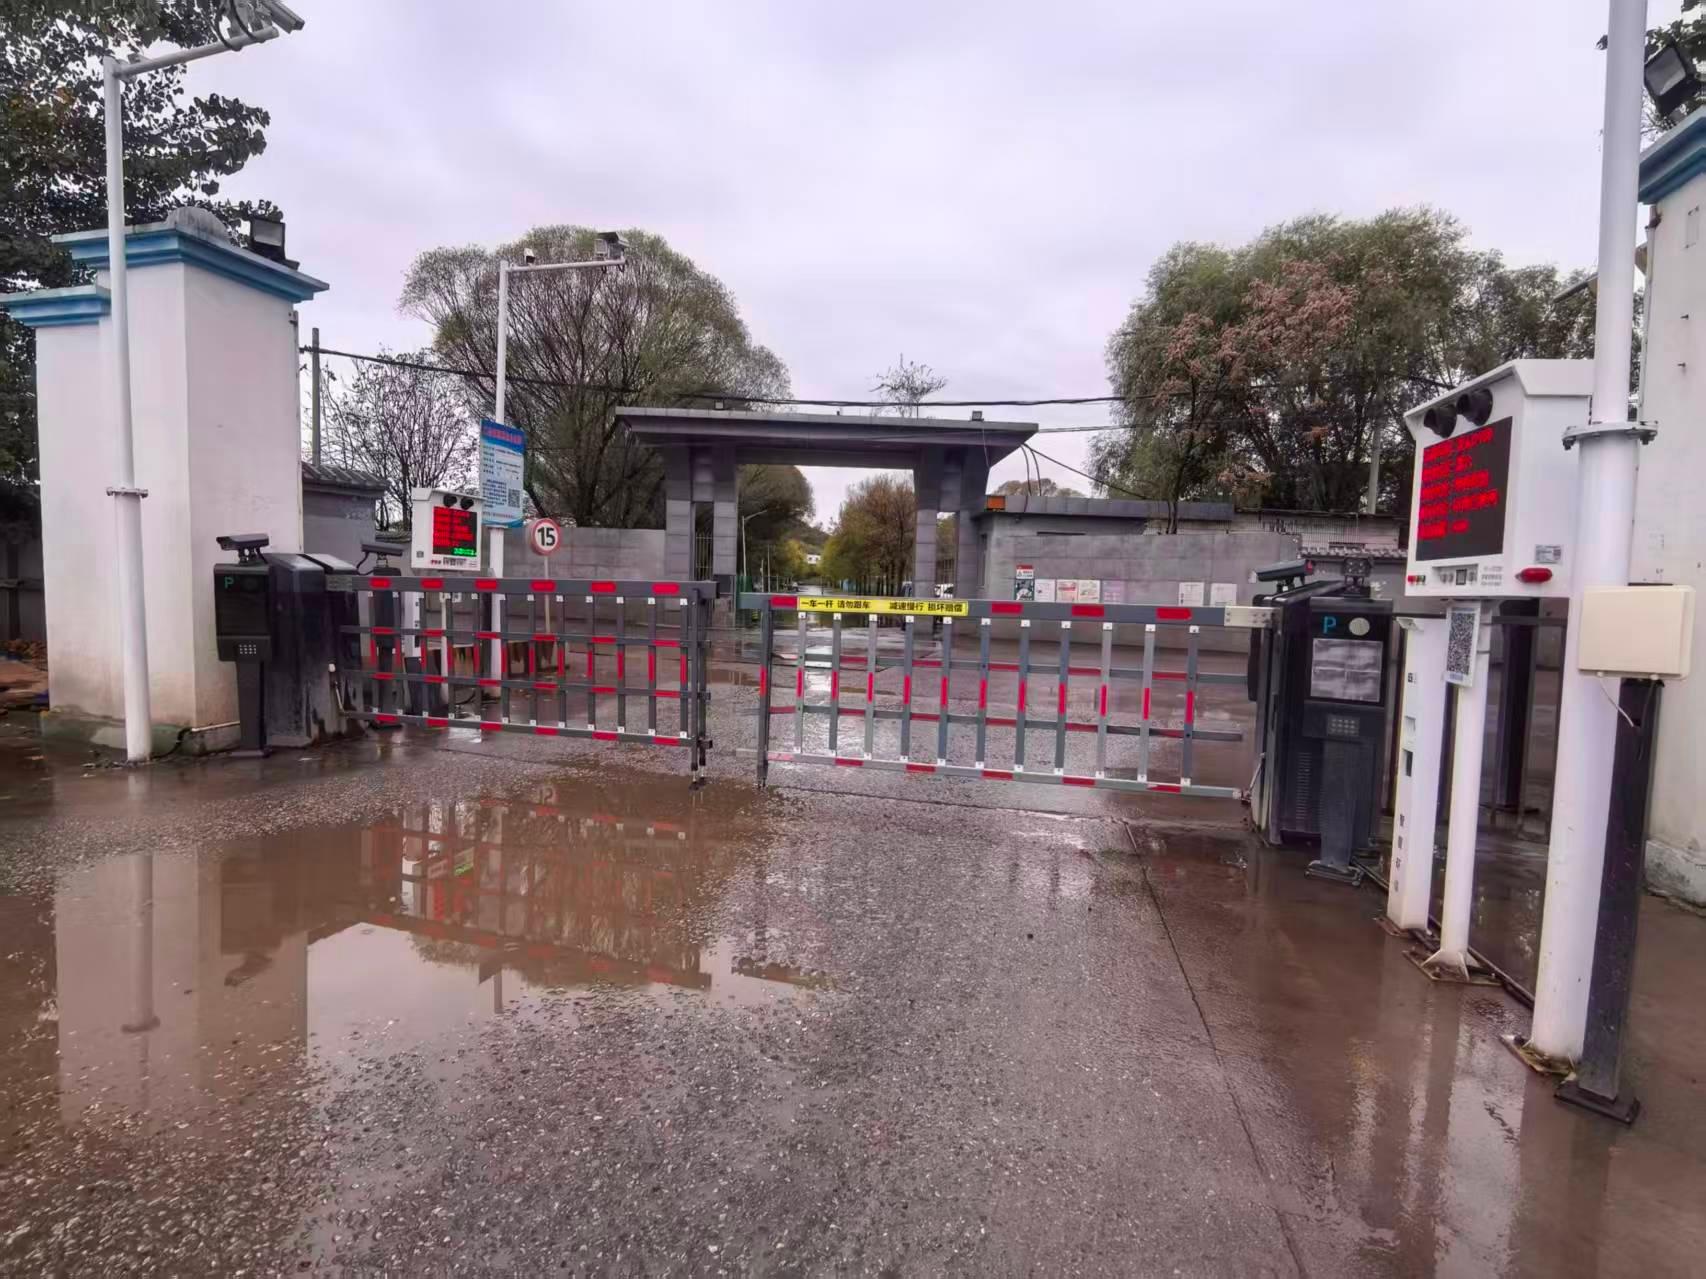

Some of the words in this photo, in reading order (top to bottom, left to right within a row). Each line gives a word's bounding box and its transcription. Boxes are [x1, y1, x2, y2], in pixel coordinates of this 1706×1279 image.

[537, 527, 556, 546] 15
[224, 576, 234, 589] P
[801, 599, 833, 608] 一车一杆
[837, 600, 870, 609] 请勿跟车
[1324, 616, 1336, 634] P
